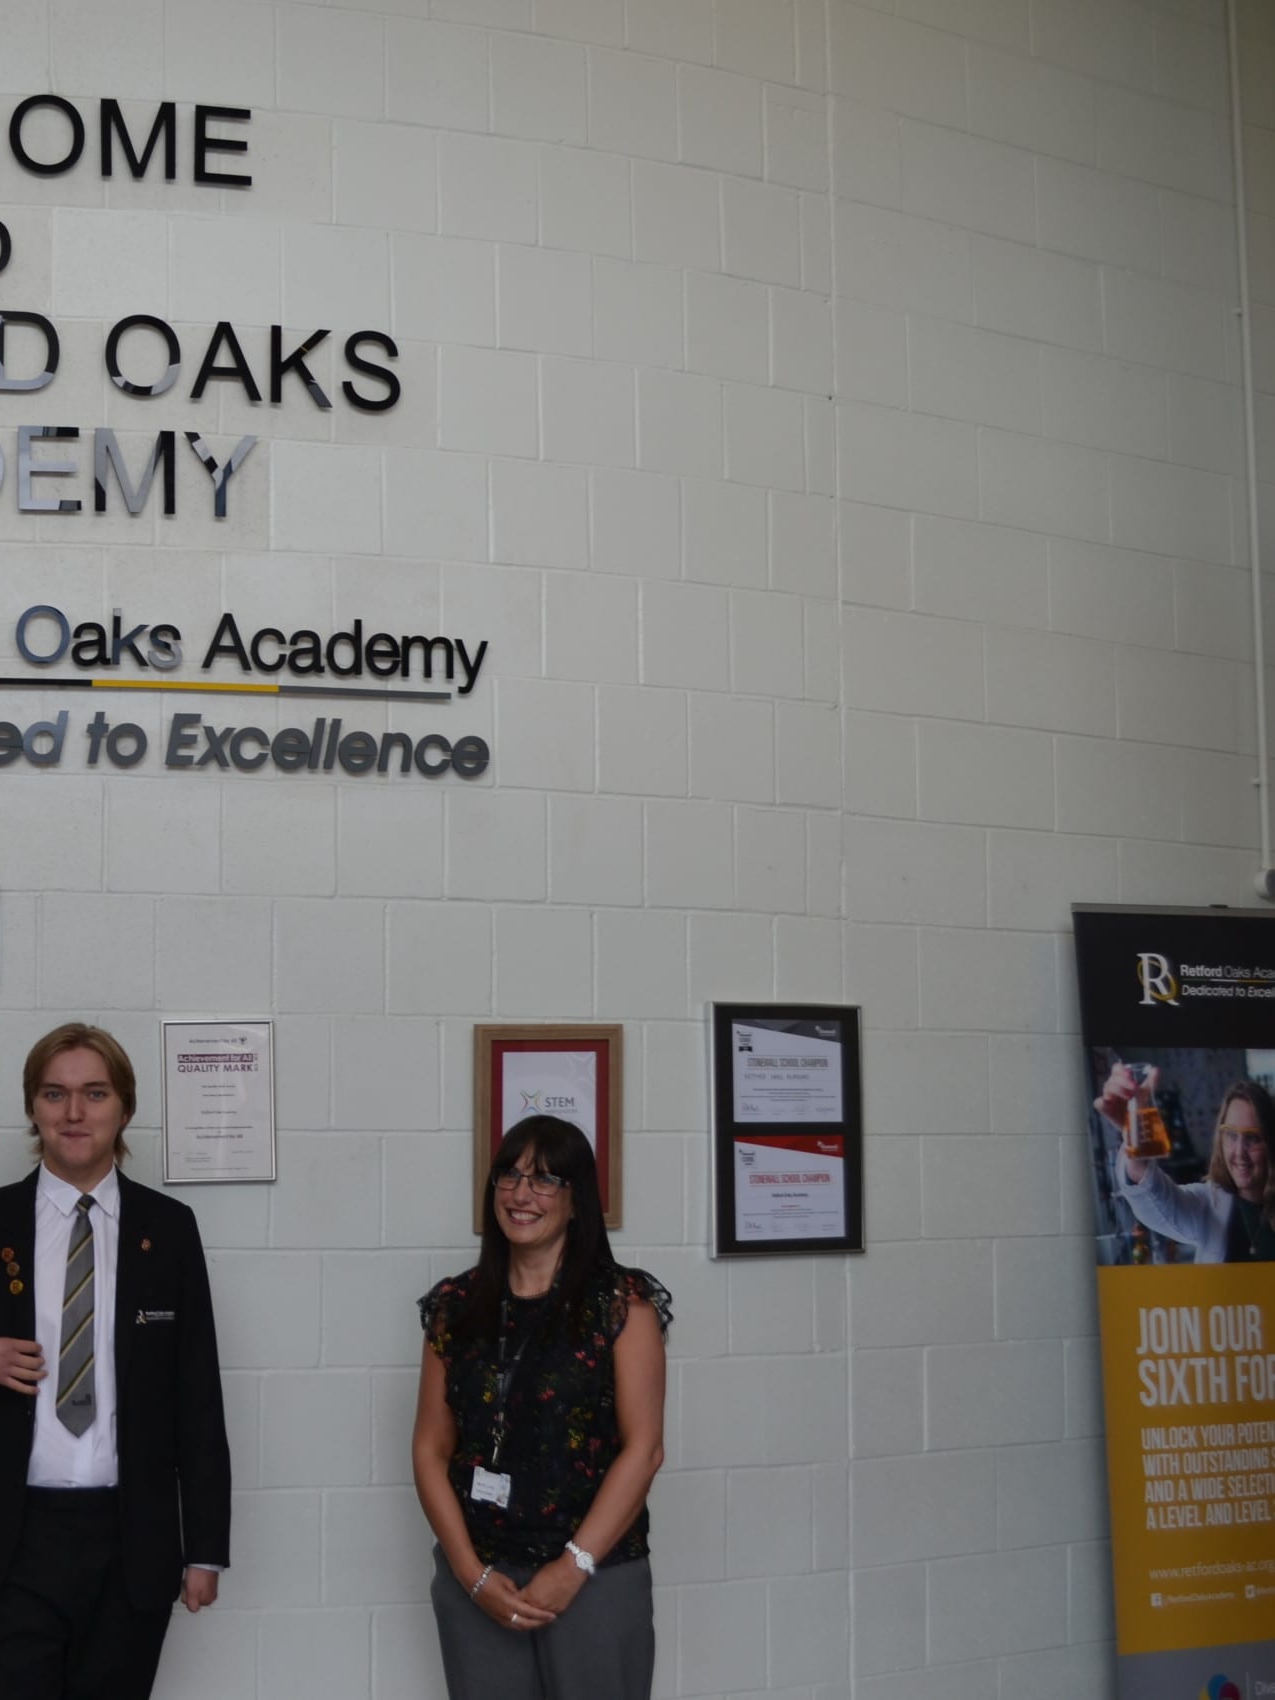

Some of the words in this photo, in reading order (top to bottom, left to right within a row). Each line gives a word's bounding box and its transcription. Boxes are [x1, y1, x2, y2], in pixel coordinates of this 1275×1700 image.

[105, 314, 401, 412] OAKS
[15, 604, 183, 670] Oaks
[201, 612, 489, 695] Academy
[86, 711, 148, 768] to
[165, 713, 490, 778] Excellence
[1180, 964, 1222, 977] Retford
[1224, 965, 1251, 978] Oaks
[1182, 985, 1233, 997] Dedicated
[1235, 986, 1245, 997] to
[178, 1064, 219, 1073] QUALITY
[223, 1064, 254, 1073] MARK
[545, 1096, 575, 1108] STEM
[1136, 1306, 1200, 1355] JOIN
[1209, 1304, 1263, 1353] OUR
[1138, 1357, 1227, 1408] SIXTH
[1141, 1425, 1198, 1450] UNLOCK
[1200, 1423, 1236, 1447] YOUR
[1142, 1453, 1180, 1477] WITH
[1183, 1447, 1269, 1474] OUTSTANDING
[1144, 1480, 1174, 1504] AND
[1178, 1479, 1188, 1502] A
[1190, 1477, 1226, 1501] WIDE
[1146, 1507, 1156, 1530] A
[1159, 1504, 1202, 1529] LEVEL
[1205, 1502, 1232, 1526] AND
[1235, 1499, 1271, 1523] LEVEL
